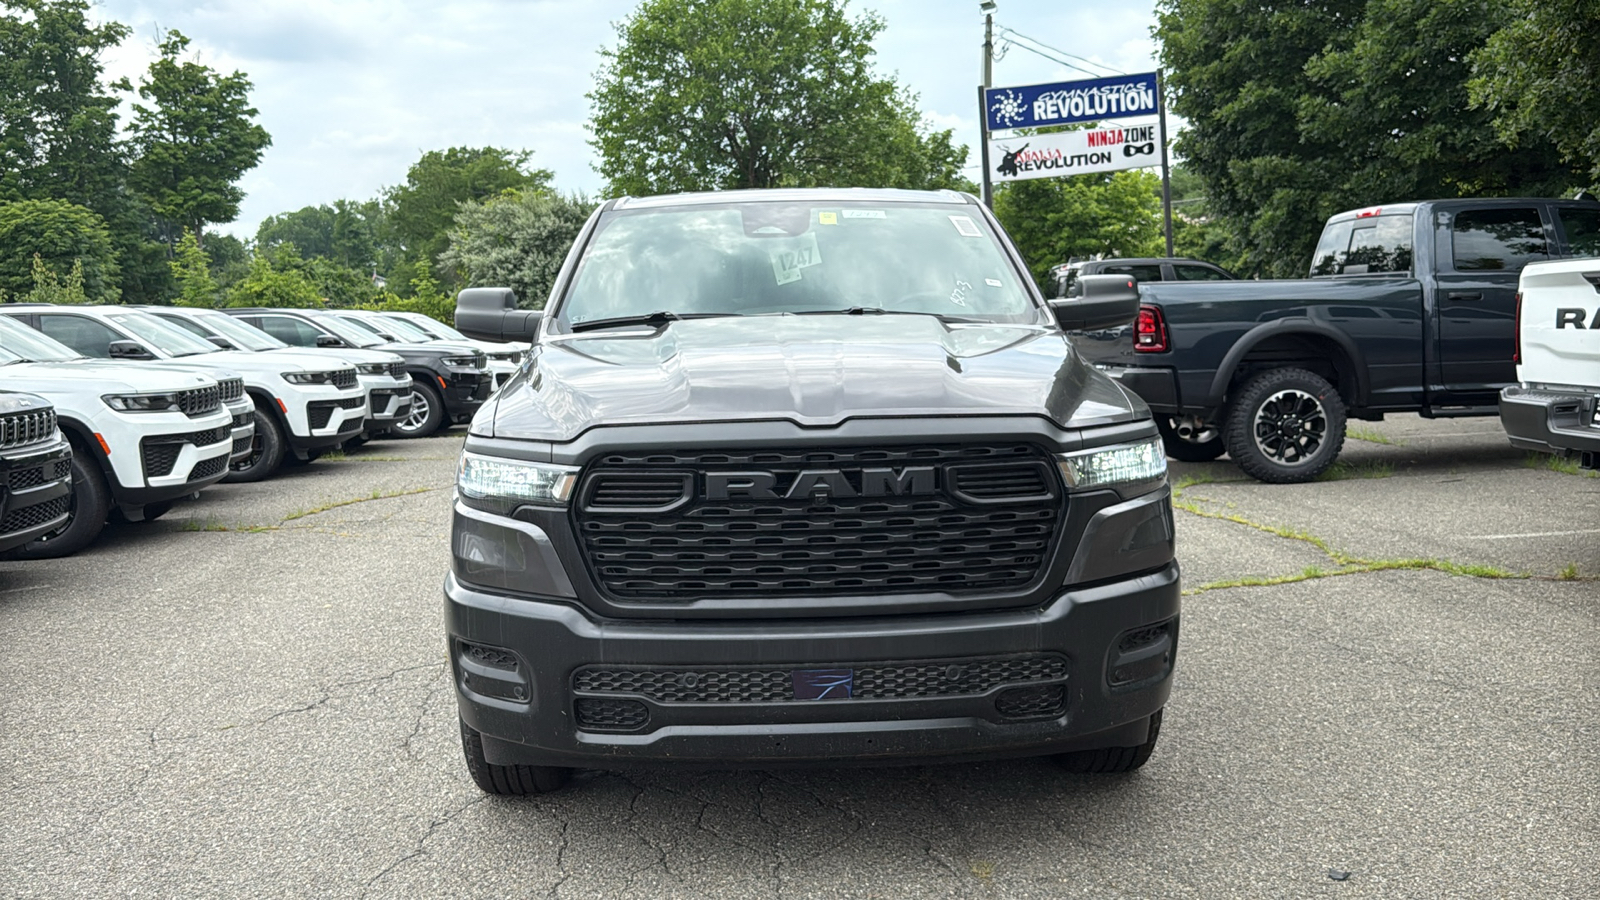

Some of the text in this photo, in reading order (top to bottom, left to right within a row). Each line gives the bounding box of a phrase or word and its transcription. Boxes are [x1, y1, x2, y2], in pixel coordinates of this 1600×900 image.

[1037, 82, 1147, 102] GYMNASTICS
[1032, 89, 1154, 121] REVOLUTION
[1087, 126, 1155, 147] NINJAZONE
[1016, 152, 1112, 172] REVOLUTION
[779, 246, 813, 271] 1247
[705, 466, 936, 499] RAM
